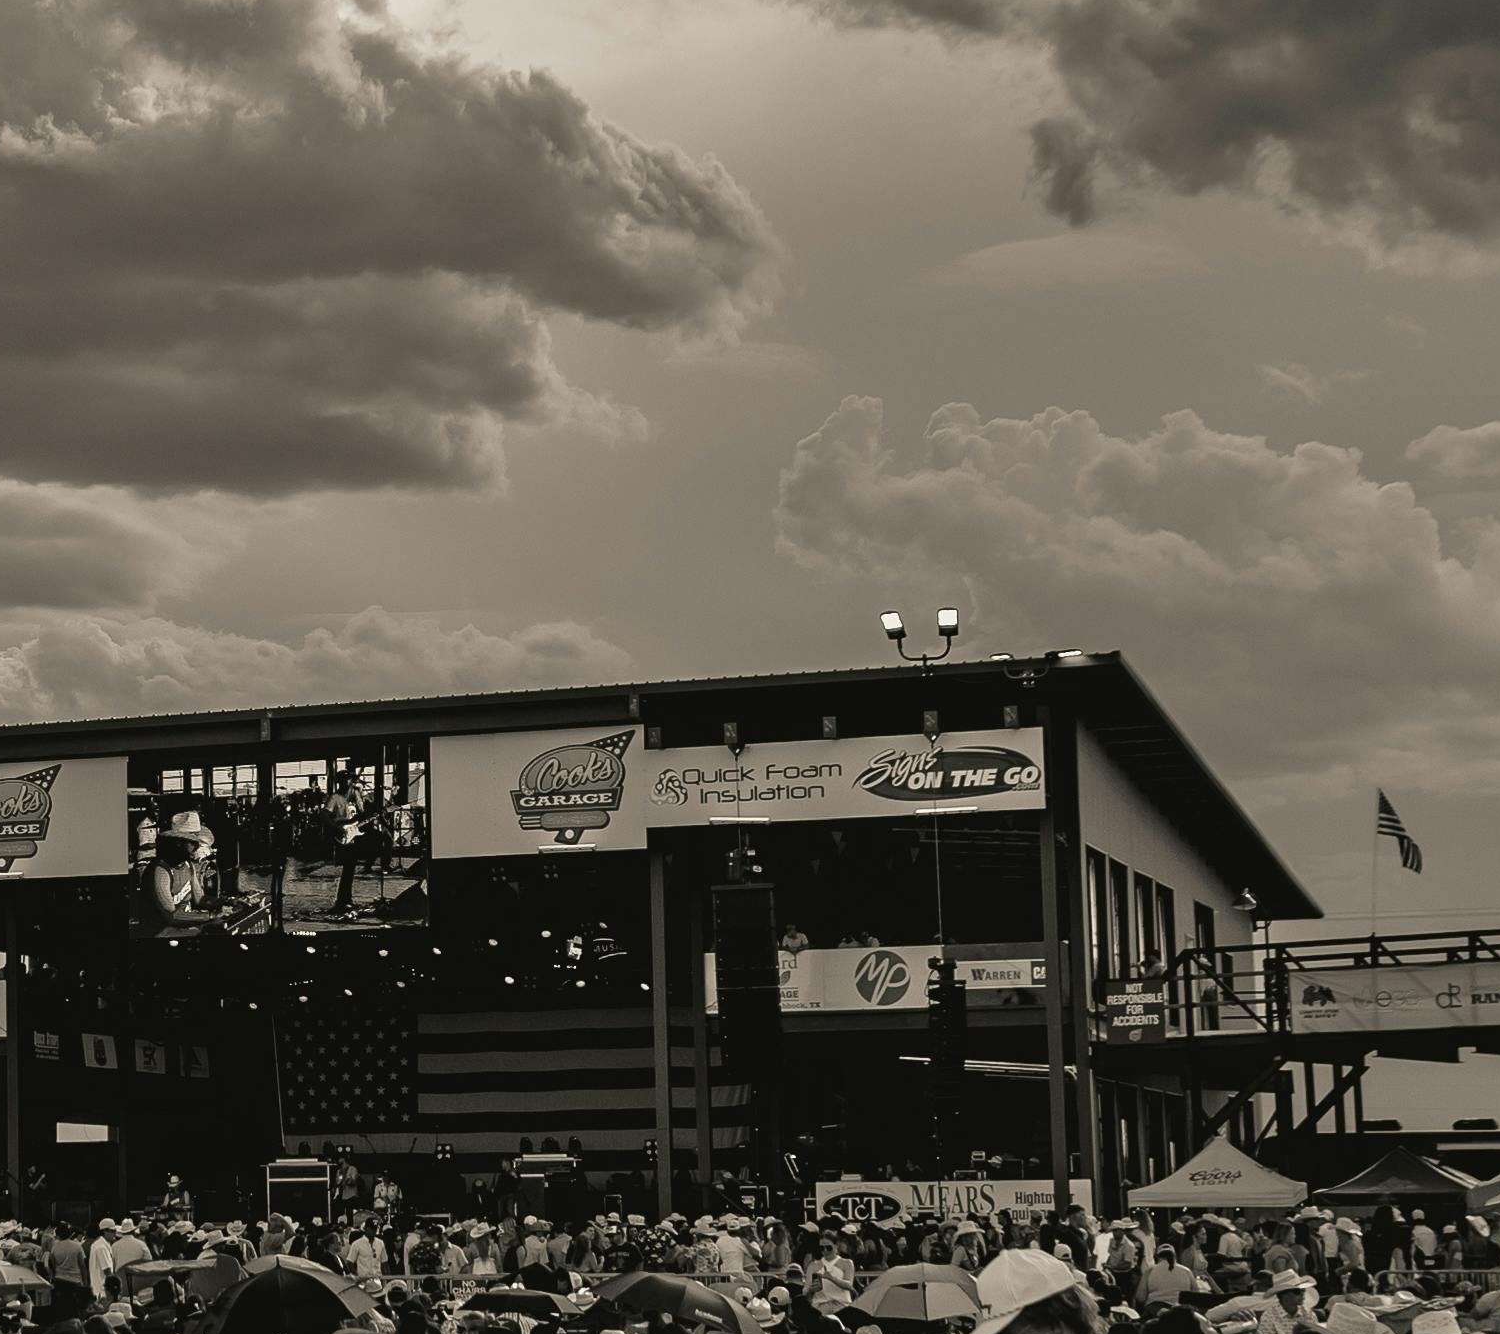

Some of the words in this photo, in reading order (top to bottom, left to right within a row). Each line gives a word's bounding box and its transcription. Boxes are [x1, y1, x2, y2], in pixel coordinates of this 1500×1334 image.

[536, 752, 614, 794] Cooks
[682, 766, 755, 785] Quick
[766, 763, 842, 780] Foam
[859, 747, 944, 789] Signs
[908, 771, 944, 790] ON
[951, 768, 996, 788] THE
[1004, 766, 1040, 785] GO
[520, 792, 612, 807] GARAGE
[700, 784, 825, 804] Insulation
[971, 968, 1021, 981] WARREN
[1125, 982, 1143, 994] NOT
[1106, 992, 1163, 1006] RESPONSIBLE
[1126, 1004, 1144, 1015] FOR
[1112, 1014, 1159, 1027] ACCIDENTS
[1189, 1169, 1243, 1182] Coors
[909, 1183, 995, 1215] MEARS
[461, 1280, 475, 1289] NO
